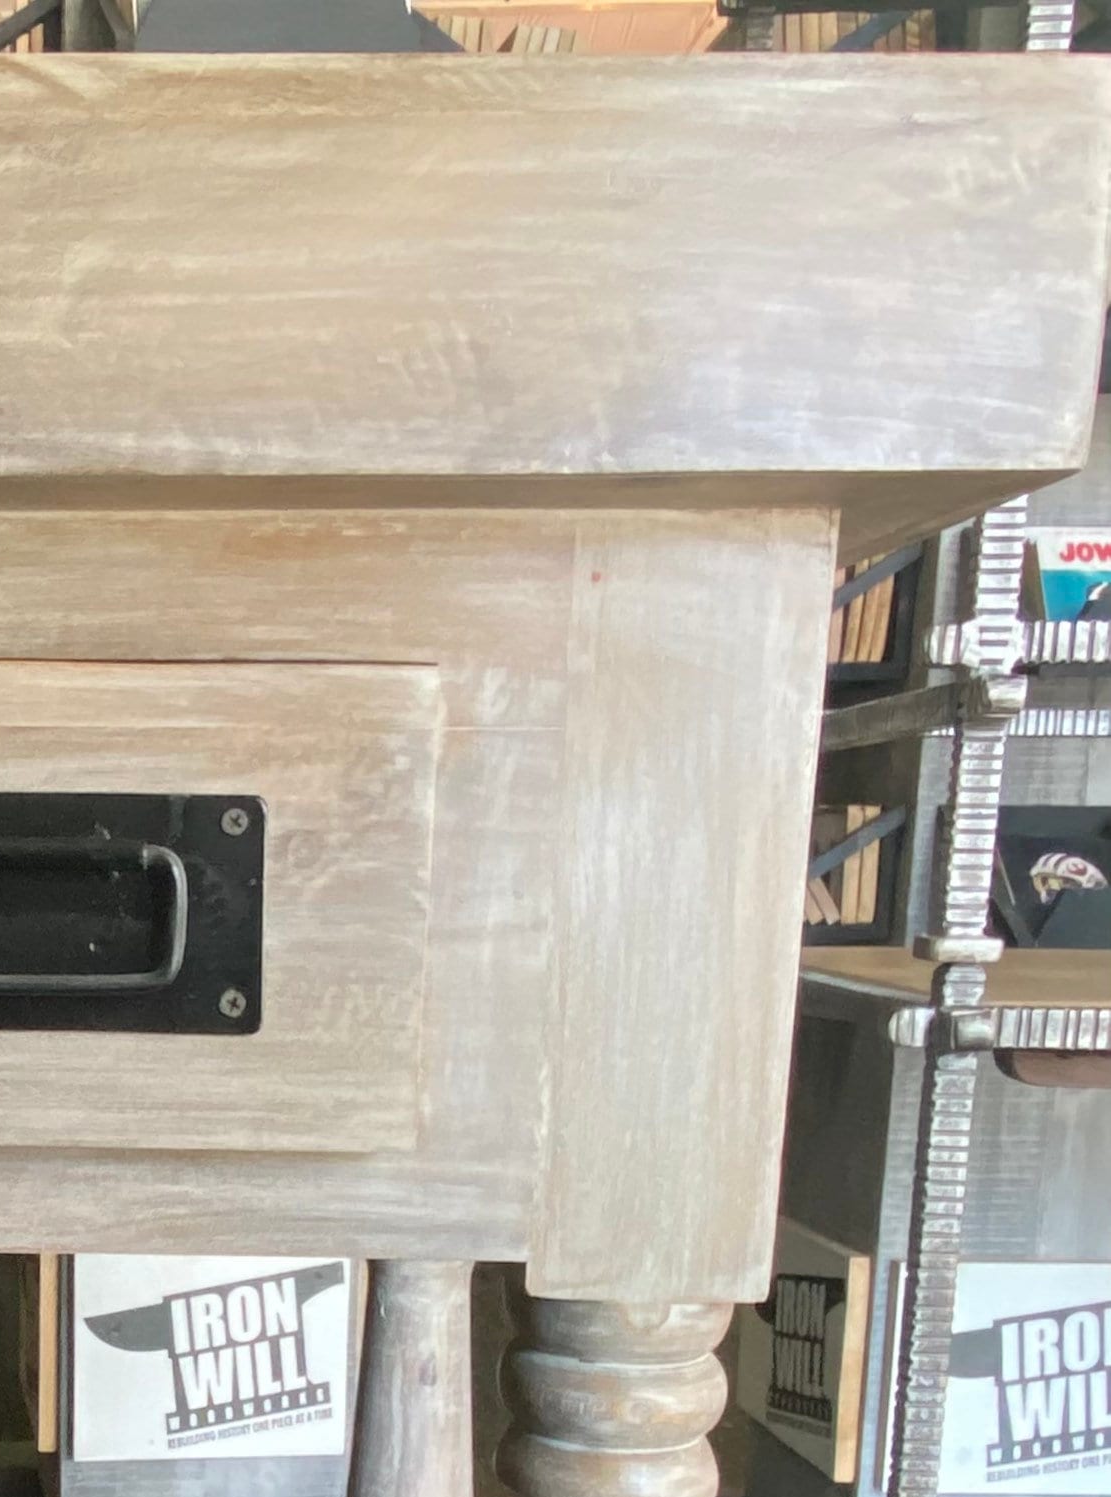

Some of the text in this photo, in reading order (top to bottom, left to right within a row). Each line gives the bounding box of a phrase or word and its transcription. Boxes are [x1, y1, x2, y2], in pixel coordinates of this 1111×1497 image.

[170, 1277, 298, 1355] IRON
[1001, 1308, 1111, 1382] IRO
[178, 1335, 307, 1410] WILL
